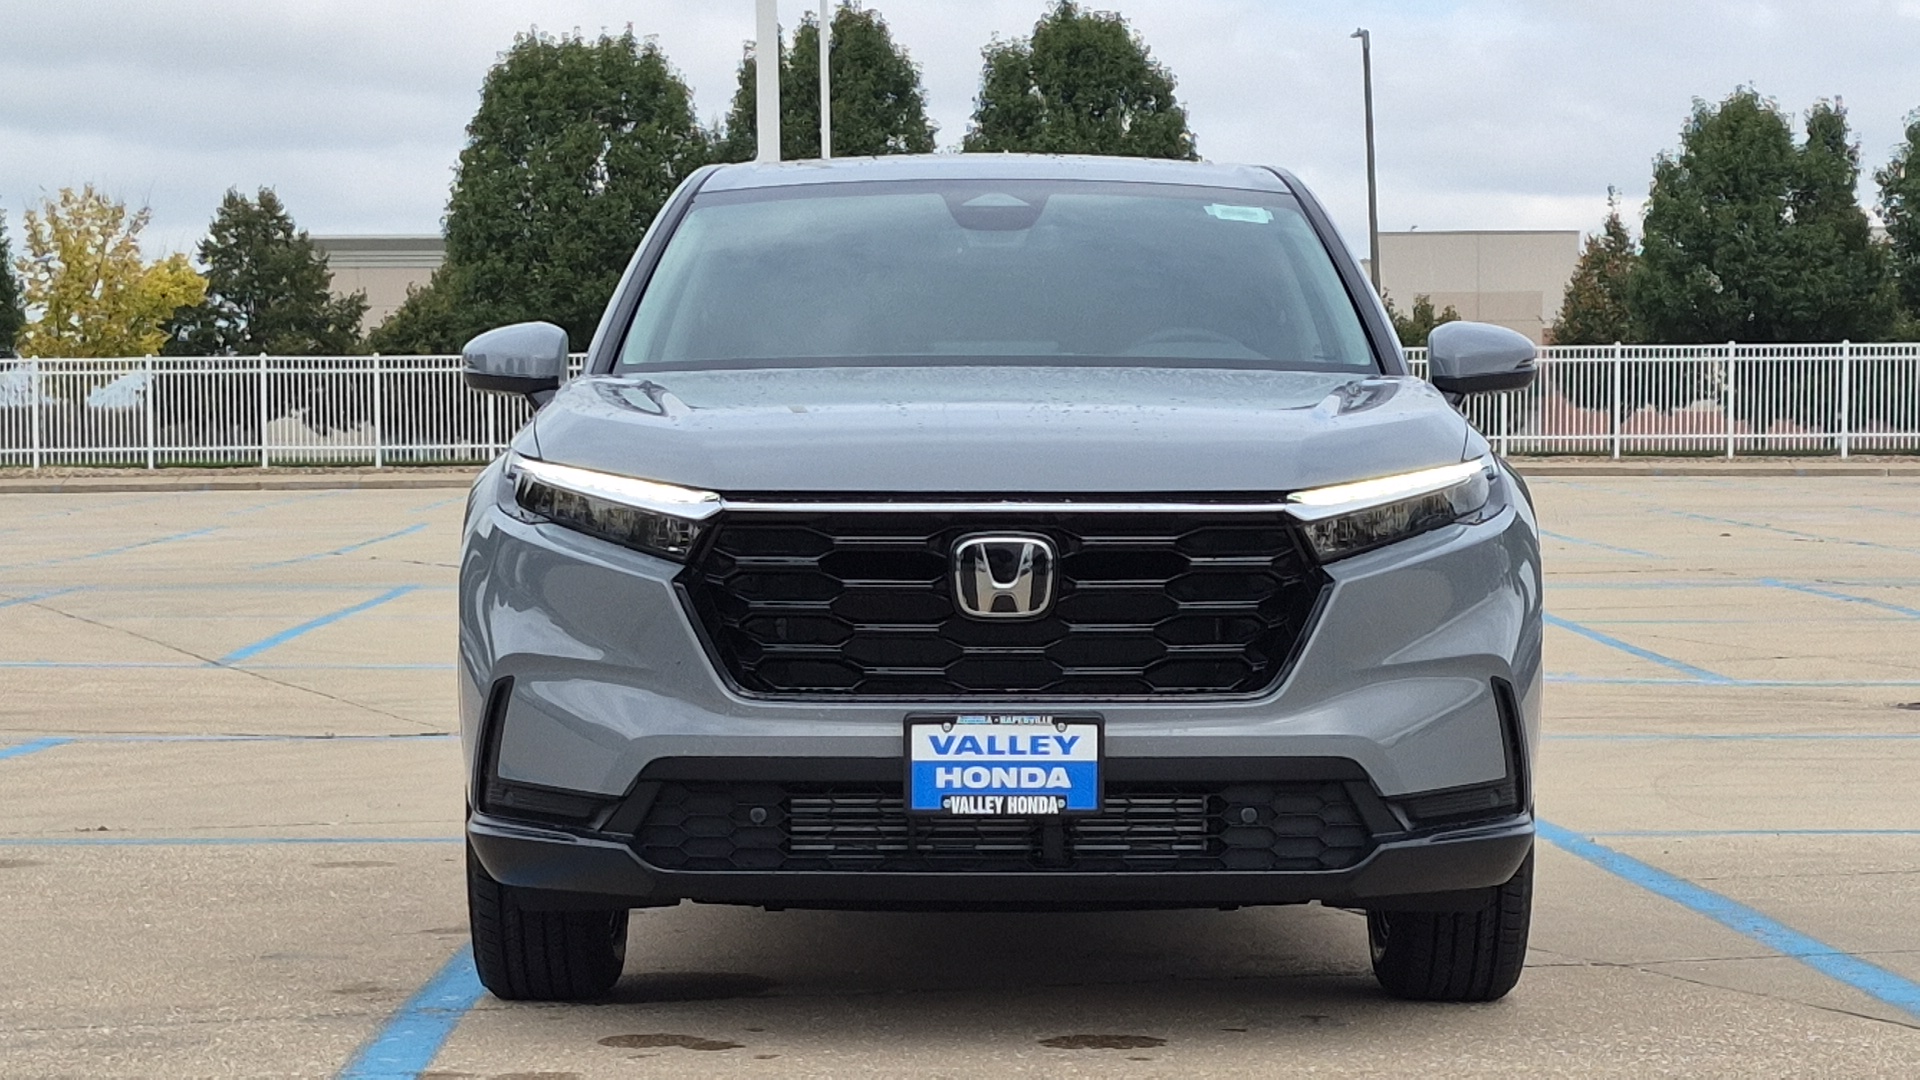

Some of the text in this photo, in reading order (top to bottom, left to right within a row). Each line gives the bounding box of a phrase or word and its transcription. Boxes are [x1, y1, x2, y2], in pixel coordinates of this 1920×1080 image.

[928, 735, 1080, 755] VALLEY
[936, 766, 1072, 788] HONDA
[952, 796, 1058, 814] VALLEY HONDA
